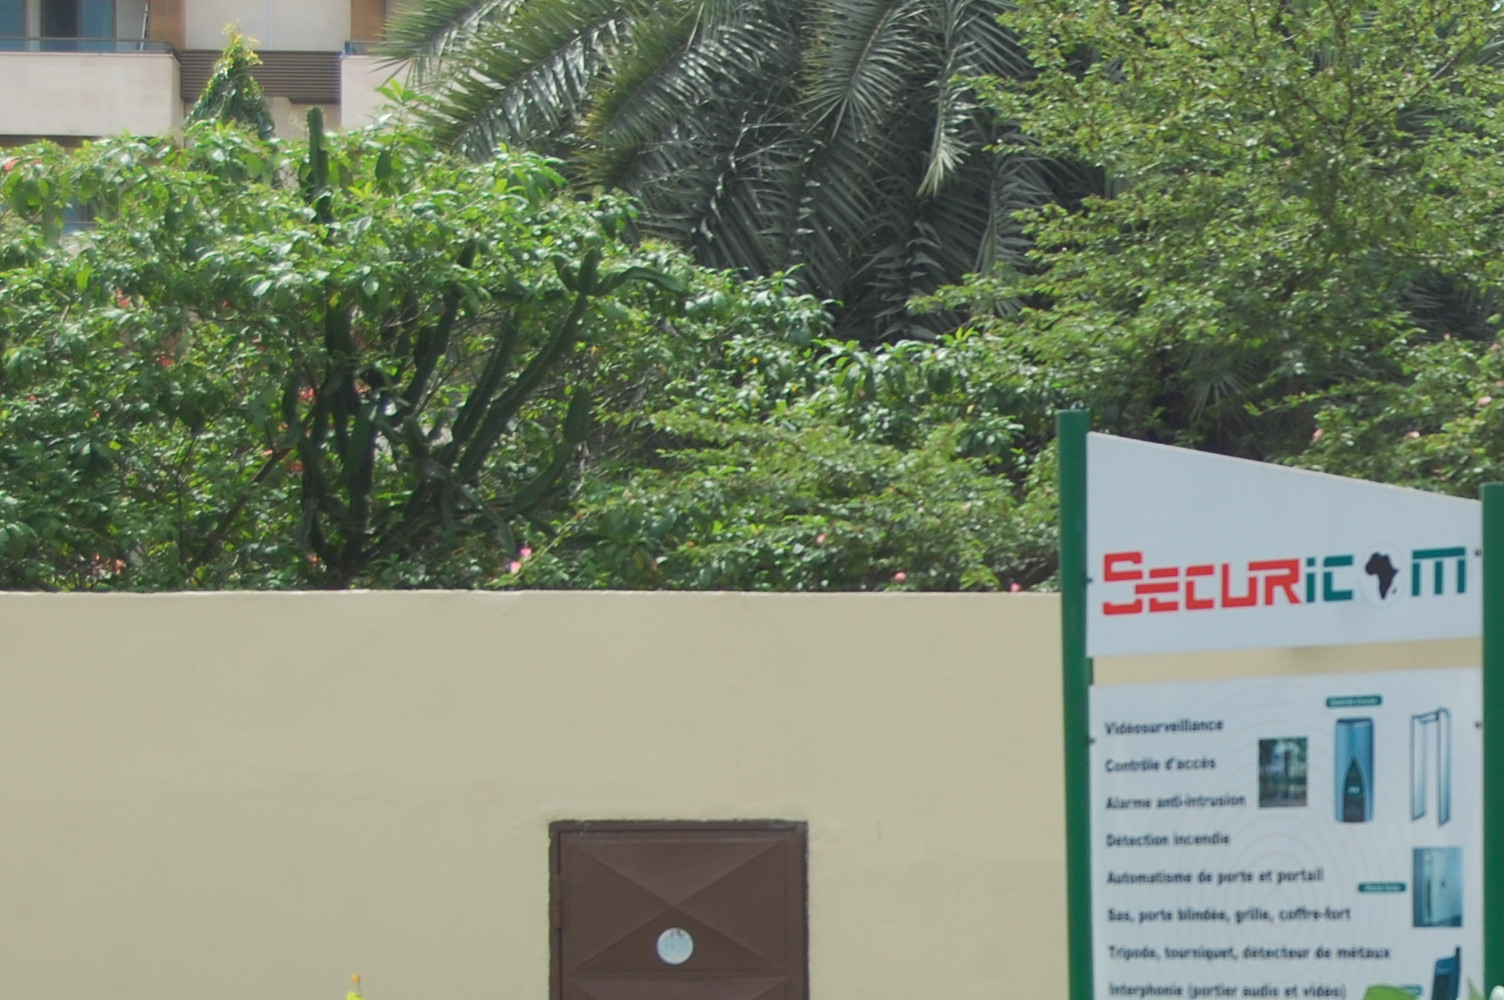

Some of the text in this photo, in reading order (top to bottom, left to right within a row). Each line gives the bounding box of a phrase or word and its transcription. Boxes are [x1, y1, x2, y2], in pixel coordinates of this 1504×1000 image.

[1105, 718, 1224, 735] Vidéosurveillance
[1105, 756, 1216, 773] Contrôle d'accès
[1106, 793, 1246, 810] Alarme anti-intrusion
[1106, 831, 1230, 848] Détection incendie
[1107, 868, 1323, 887] Automatisme de porte et portail
[1139, 908, 1173, 925] porte
[1279, 906, 1351, 921] coffre-fort
[1243, 945, 1309, 960] détecteur
[1316, 946, 1331, 959] de
[1337, 945, 1391, 960] métaux
[1109, 983, 1182, 1000] Interphonie
[1243, 983, 1278, 998] audio
[1284, 984, 1298, 997] et
